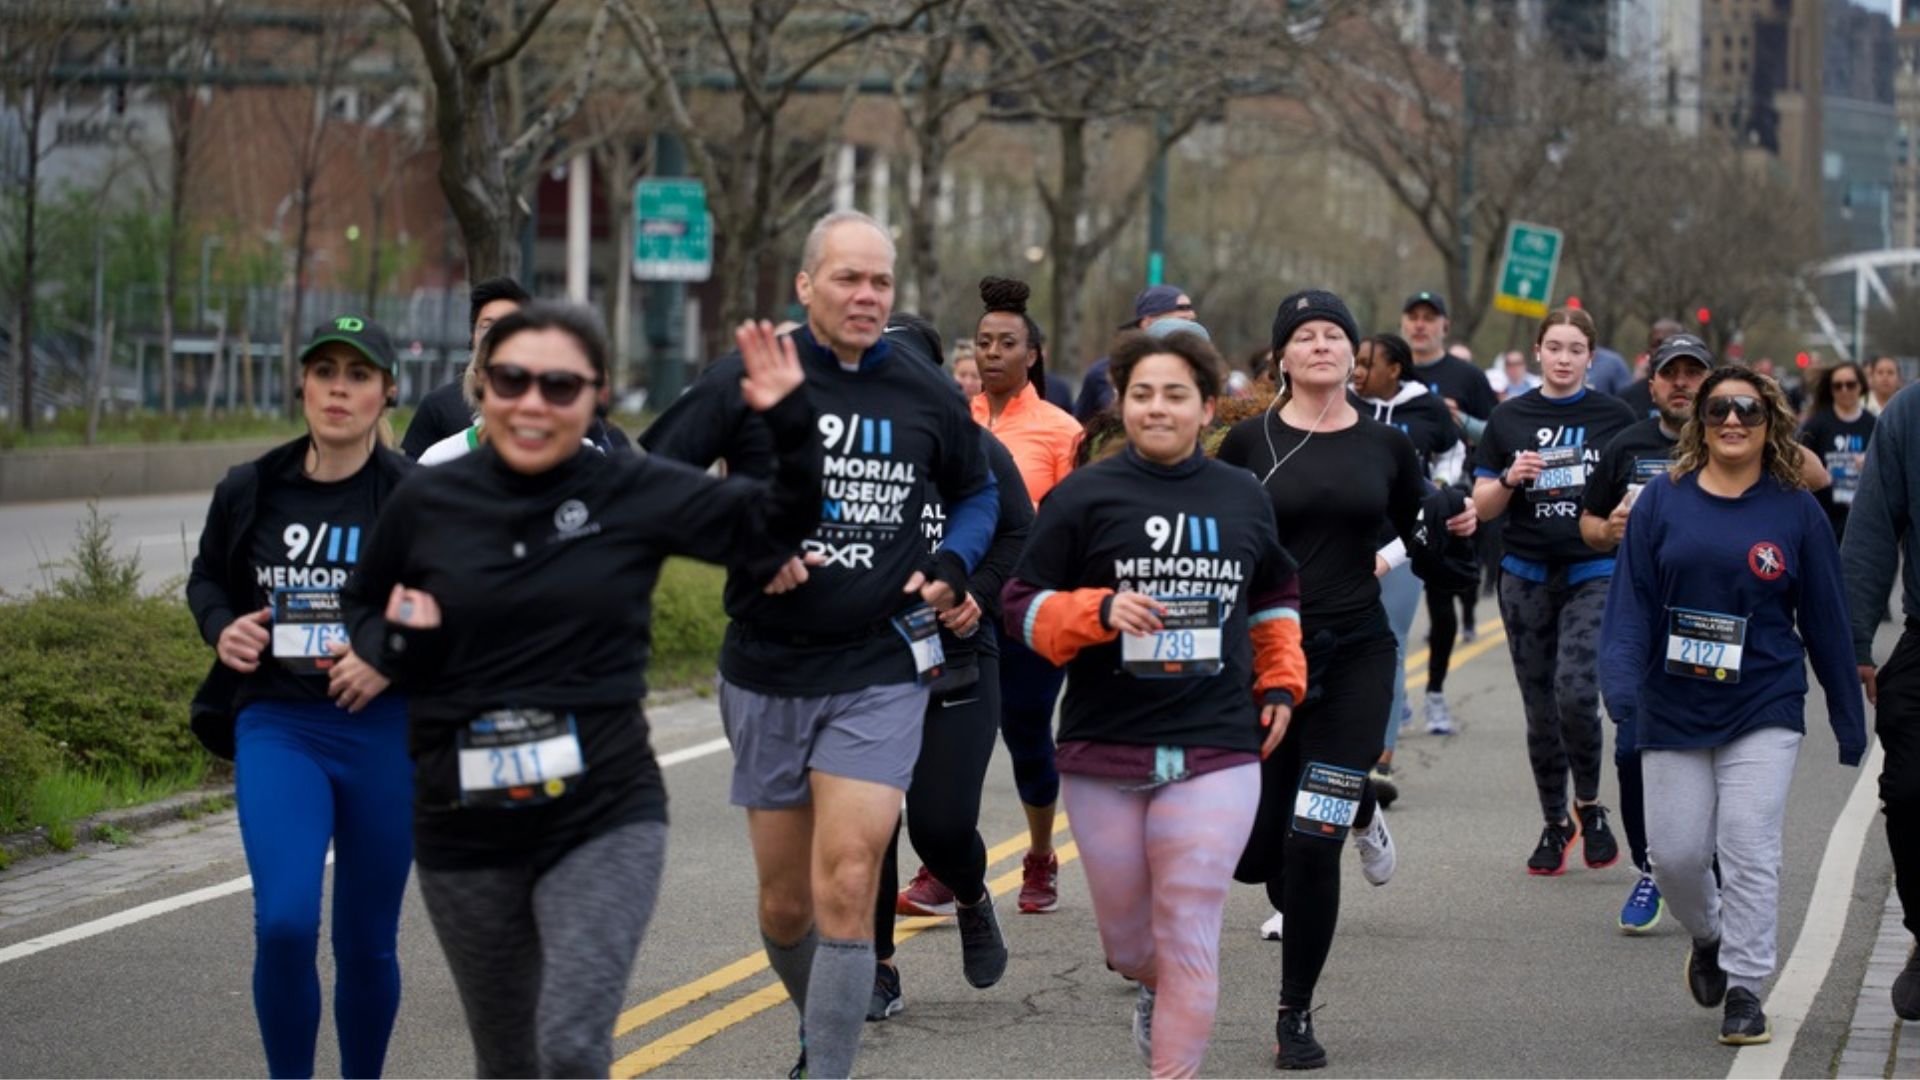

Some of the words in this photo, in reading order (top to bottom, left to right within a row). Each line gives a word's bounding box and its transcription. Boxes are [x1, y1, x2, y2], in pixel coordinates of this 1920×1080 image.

[818, 413, 892, 455] 9/11
[1536, 425, 1586, 448] 9/11
[823, 455, 916, 483] MORIAL
[822, 478, 911, 505] USEUM
[821, 499, 904, 524] NWALK
[1535, 500, 1577, 519] RXR
[283, 522, 360, 566] 9/11
[1144, 512, 1219, 556] 9/11
[801, 538, 875, 569] RXR
[256, 565, 349, 588] MEMOR
[1114, 556, 1244, 582] MEMORIAL
[1138, 579, 1239, 603] MUSEUM
[1153, 629, 1195, 660] 739
[1681, 638, 1726, 667] 2127
[489, 742, 542, 788] 211
[1308, 792, 1352, 825] 2885
